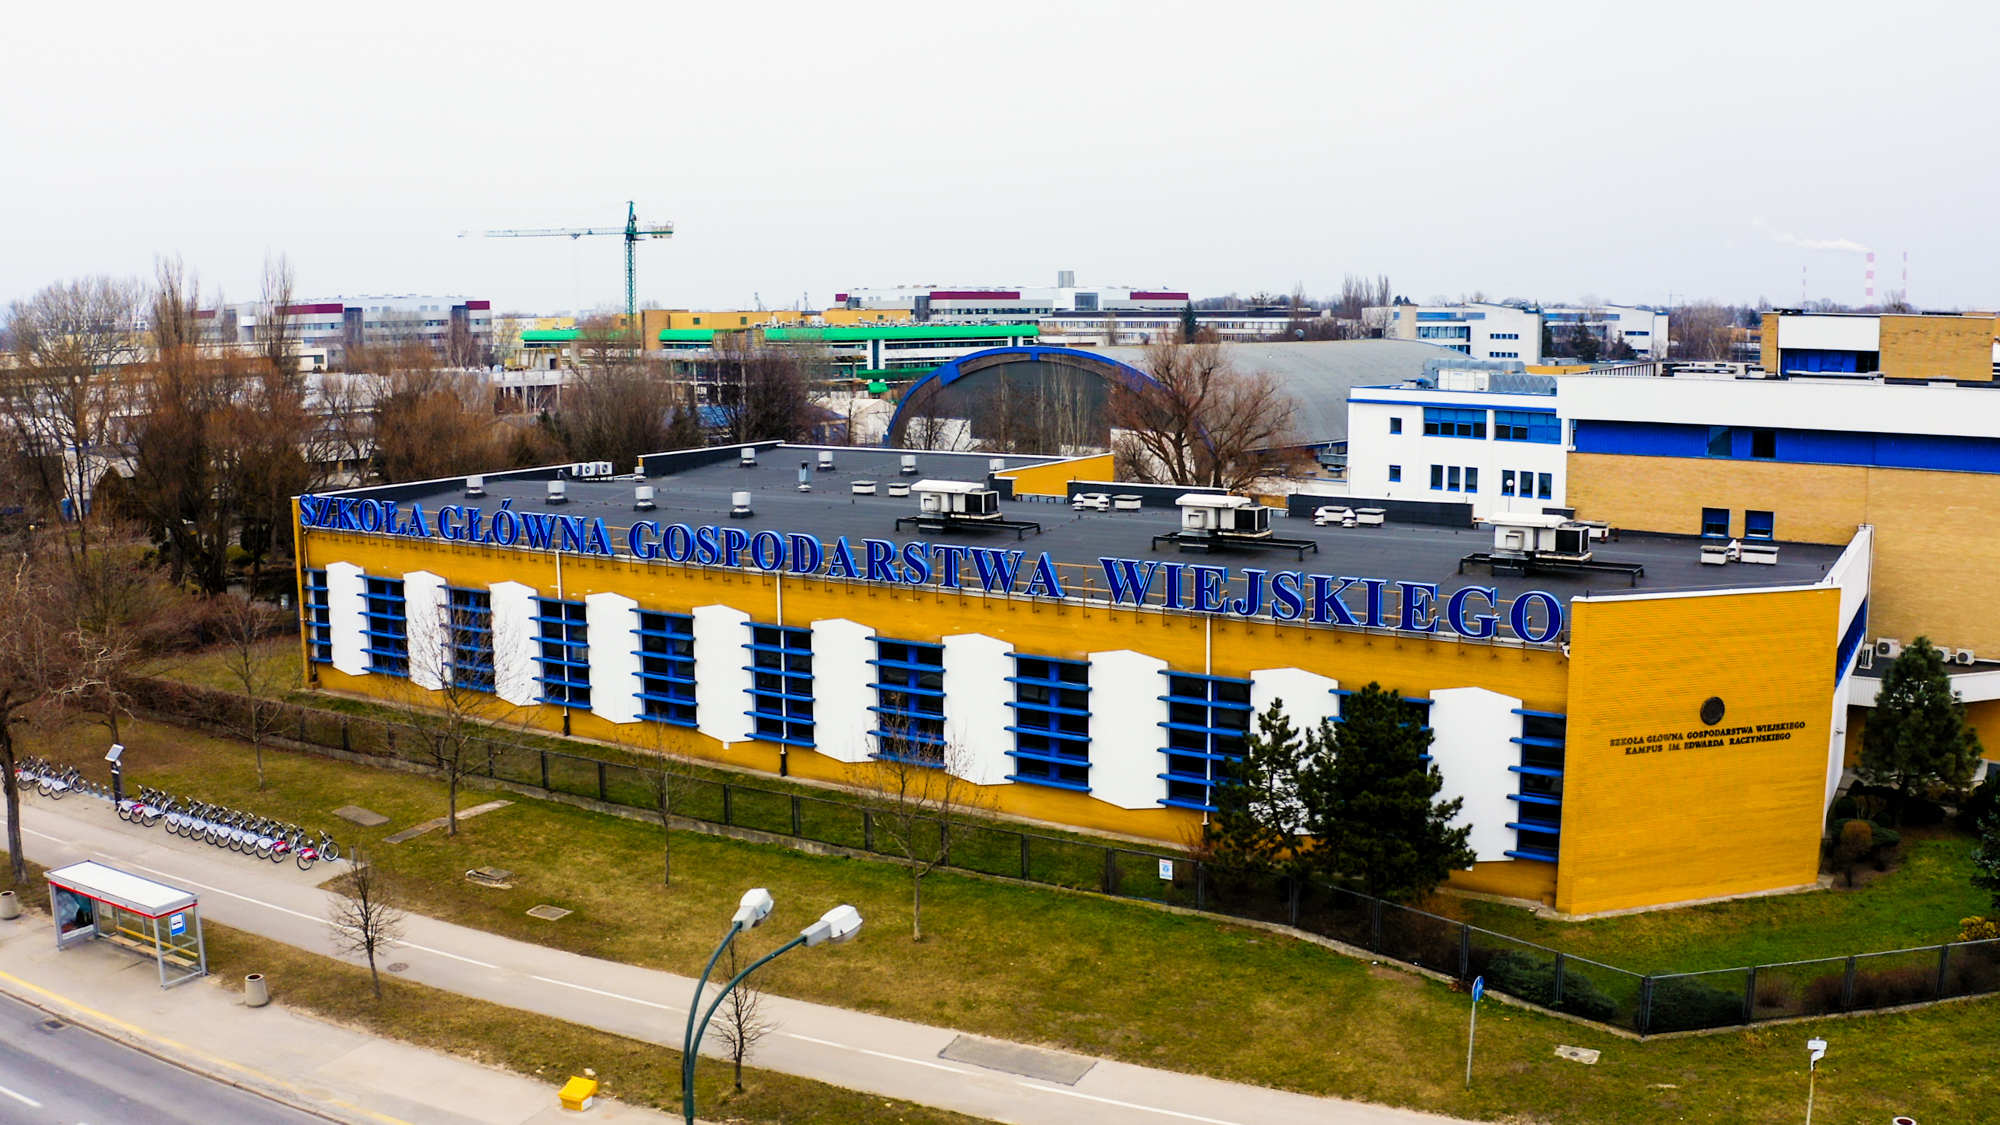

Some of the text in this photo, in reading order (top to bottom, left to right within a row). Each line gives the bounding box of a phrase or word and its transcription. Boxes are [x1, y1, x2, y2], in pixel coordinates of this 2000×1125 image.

[299, 494, 1564, 644] SZKOŁA GŁÓWNA GOSPODARSTWA WIEJSKIEGO
[1610, 737, 1644, 747] SZKOŁA
[1687, 727, 1753, 739] GOSPODARSTWA
[1756, 721, 1805, 732] WIEJSKIEGO
[1625, 745, 1663, 755] KAMPUS
[1684, 739, 1724, 749] EDWARDA
